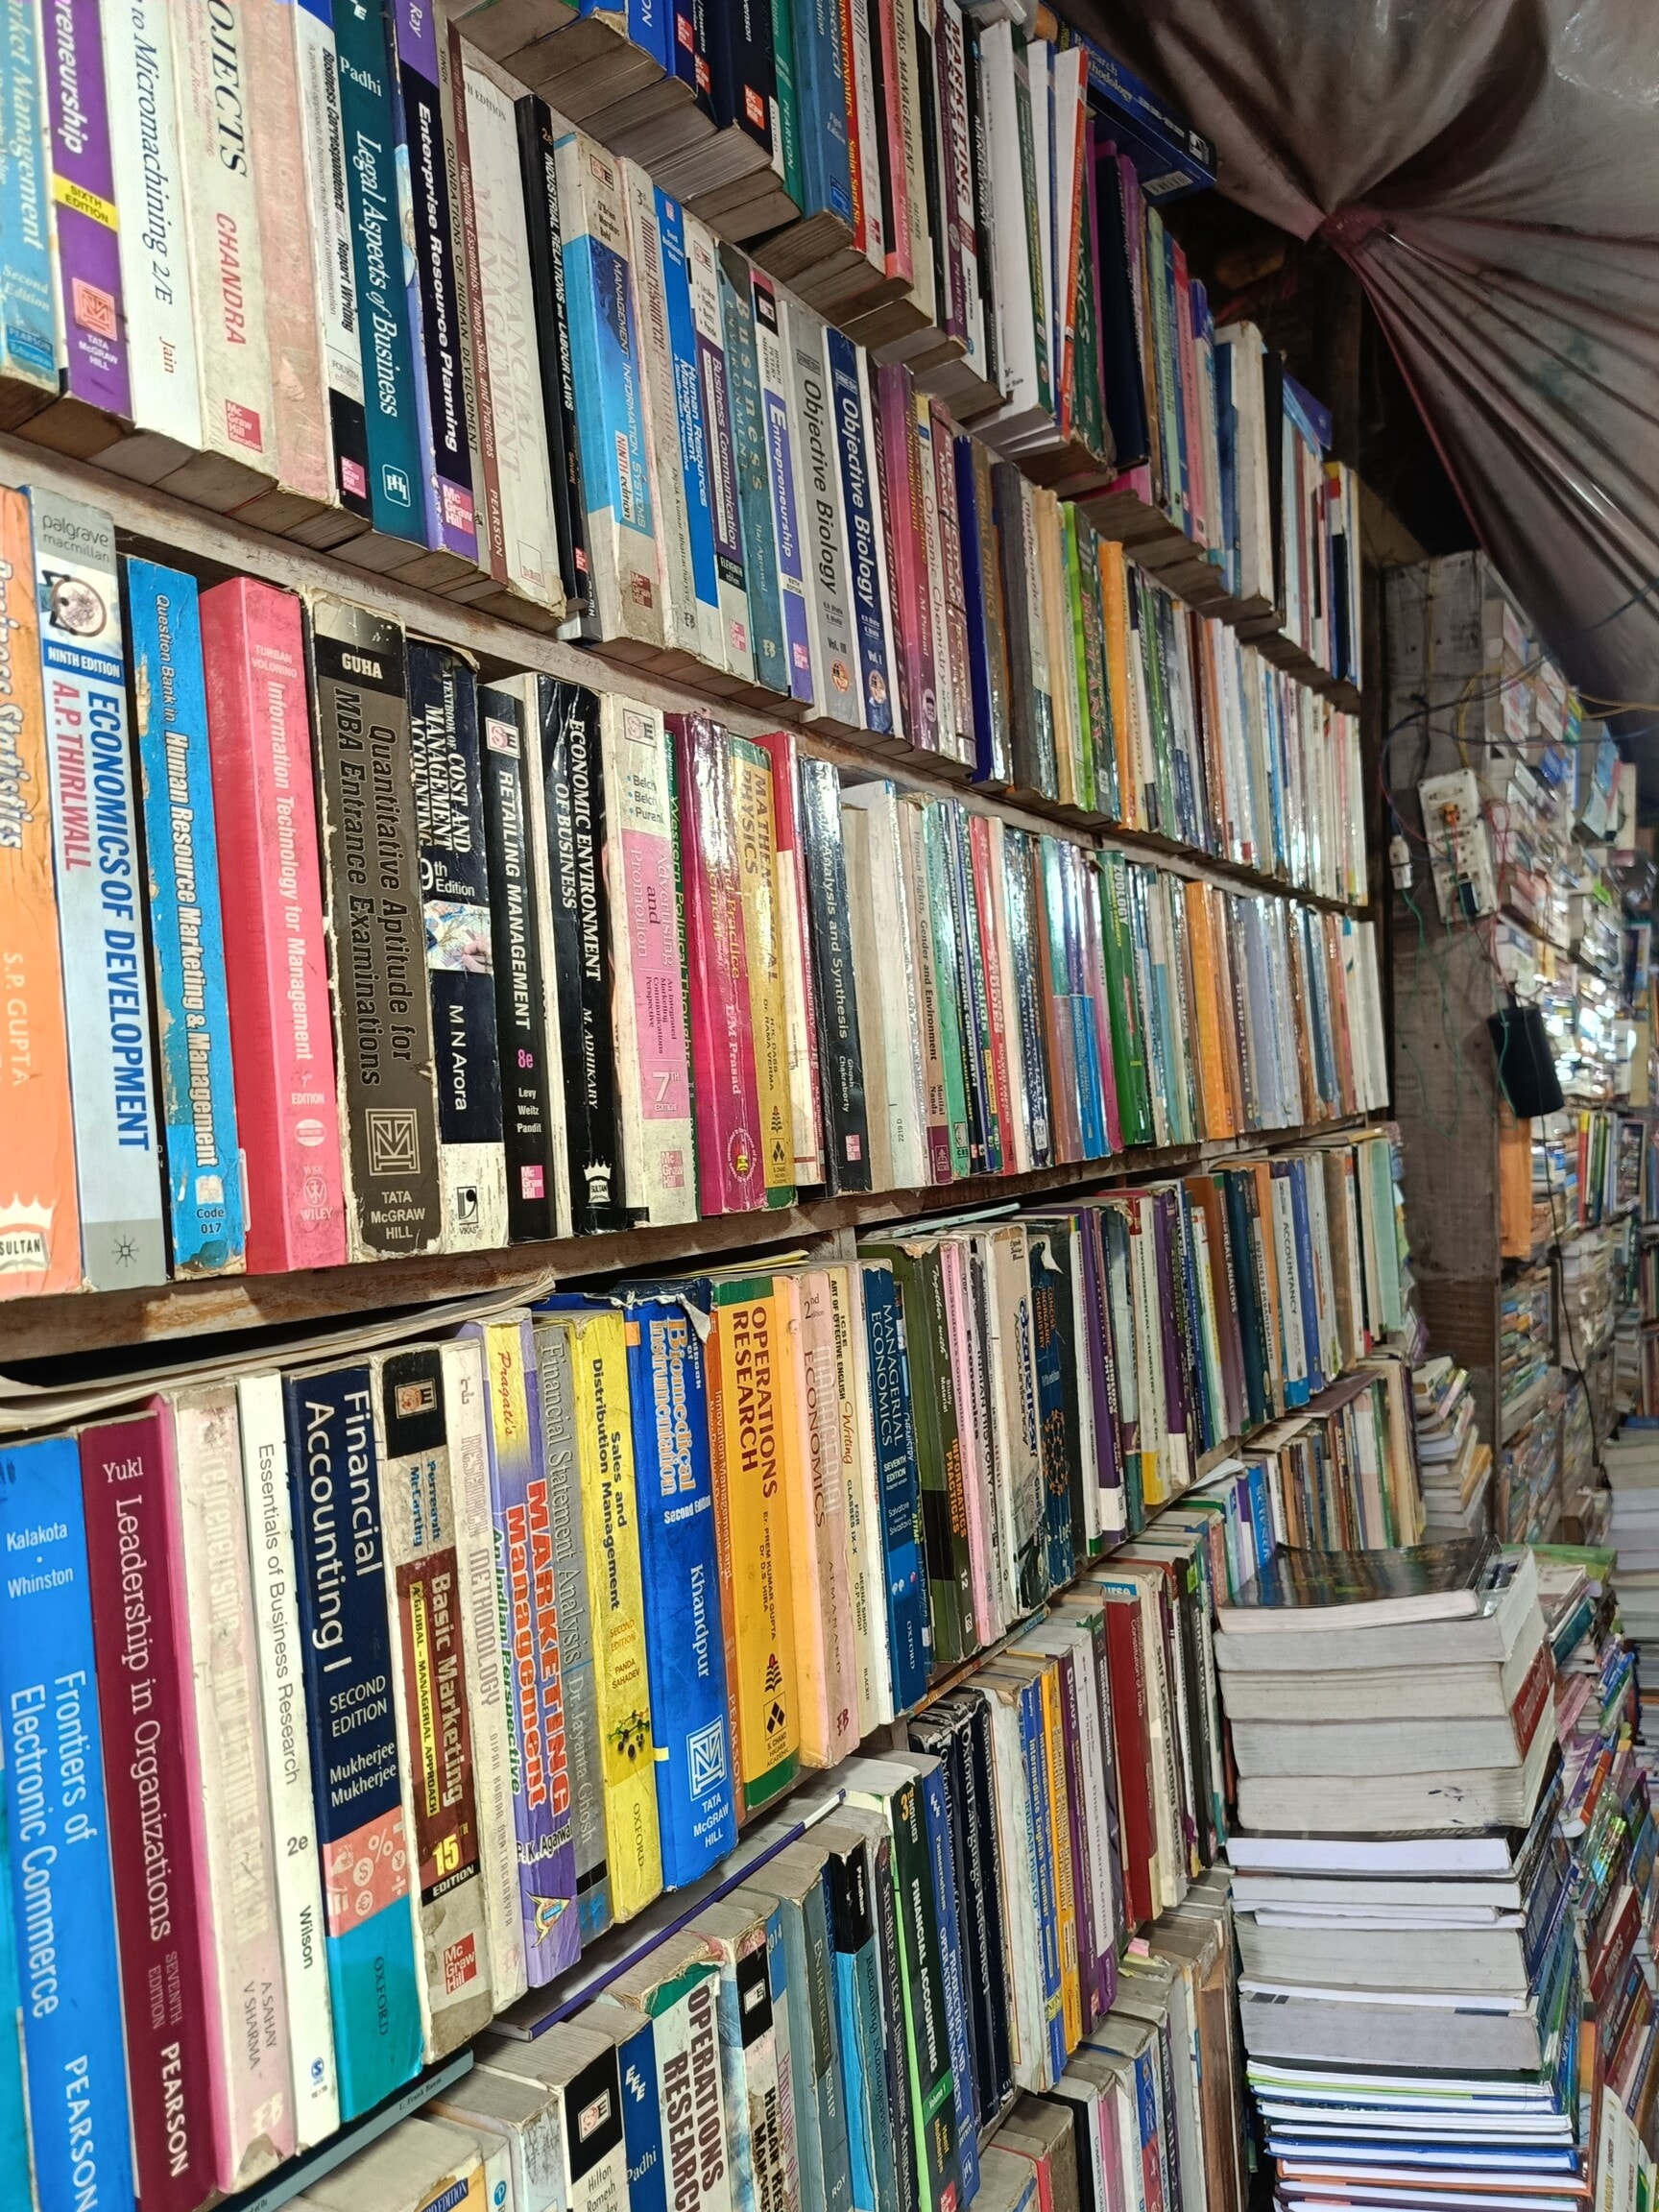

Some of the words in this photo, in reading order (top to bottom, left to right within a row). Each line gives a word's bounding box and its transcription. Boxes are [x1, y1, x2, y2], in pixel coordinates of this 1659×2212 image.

[339, 56, 382, 97] Padhi
[782, 98, 795, 170] PEARSON
[898, 58, 915, 176] MANAGEMENT
[951, 21, 971, 206] MARKETING
[70, 185, 103, 209] SIXTH
[352, 130, 387, 204] Legal
[419, 102, 440, 230] Enterprise
[65, 196, 110, 225] EDITION
[358, 198, 392, 291] Aspects
[216, 212, 247, 345] CHANDRA
[365, 290, 392, 318] of
[428, 234, 450, 348] Resource
[159, 336, 178, 373] Jain
[372, 313, 400, 418] Business
[439, 351, 459, 452] Planning
[770, 403, 793, 558] Entrepreneurship
[803, 379, 828, 492] Objective
[816, 500, 839, 594] Biology
[840, 397, 868, 509] Objective
[41, 513, 109, 547] palgrave
[42, 532, 110, 564] macmillan
[490, 488, 505, 566] PEARSON
[853, 515, 876, 609] Biology
[923, 494, 939, 580] Organic
[932, 586, 948, 691] Chemistry
[156, 593, 177, 662] Question
[48, 646, 83, 670] NINTH
[81, 653, 122, 679] EDITION
[160, 664, 177, 706] Bank
[341, 651, 383, 681] GUHA
[53, 679, 83, 727] A.P.
[164, 707, 177, 725] in
[265, 679, 295, 791] Information
[333, 686, 365, 752] MBA
[87, 689, 132, 880] ECONOMICS
[163, 728, 190, 805] Human
[424, 703, 455, 854] MANAGEMENT
[446, 752, 470, 806] COST
[555, 781, 570, 817] OF
[569, 718, 594, 840] ECONOMIC
[632, 776, 657, 792] Belch
[56, 732, 92, 872] THIRLWALL
[339, 758, 369, 886] Entrance
[367, 723, 406, 890] Quantitative
[450, 808, 474, 854] AND
[498, 768, 522, 878] RETAILING
[169, 805, 198, 904] Resource
[276, 795, 302, 900] Technology
[556, 820, 578, 909] BUSINESS
[100, 879, 134, 922] OF
[284, 905, 304, 932] for
[436, 878, 476, 898] Edition
[578, 841, 602, 982] ENVIRONMENT
[646, 886, 661, 924] and
[3, 950, 26, 989] S.P.
[177, 904, 207, 1013] Marketing
[377, 898, 416, 1015] Aptitude
[505, 883, 532, 1031] MANAGEMENT
[826, 923, 843, 957] and
[920, 920, 931, 961] Gender
[287, 938, 315, 1061] Management
[348, 893, 389, 1087] Examinations
[829, 961, 850, 1039] Synthesis
[923, 964, 933, 985] and
[6, 998, 32, 1088] GUPTA
[104, 928, 150, 1151] DEVELOPMENT
[183, 1012, 206, 1030] &
[386, 1022, 417, 1064] for
[924, 989, 939, 1061] Environment
[517, 1048, 535, 1070] 8e
[837, 1054, 850, 1116] Chakraborty
[846, 1058, 855, 1089] Ghosh
[186, 1029, 221, 1169] Management
[517, 1120, 542, 1135] Pandit
[518, 1087, 538, 1100] Levy
[518, 1104, 540, 1117] Weitz
[930, 1086, 939, 1115] Nanda
[196, 1206, 225, 1219] Code
[200, 1221, 223, 1236] 017
[300, 1207, 334, 1222] WILEY
[370, 1207, 426, 1225] McGRAW
[382, 1190, 413, 1205] TATA
[0, 1238, 41, 1256] SULTAN
[385, 1225, 414, 1240] HILL
[1226, 1262, 1238, 1313] ANALYSIS
[1282, 1221, 1298, 1315] ACCOUNTANCY
[1035, 1290, 1046, 1350] CHEMISTRY
[1039, 1287, 1051, 1347] INORGANIC
[496, 1350, 515, 1437] Pragati's
[541, 1344, 574, 1450] Financial
[649, 1319, 679, 1497] Instrumentation
[667, 1315, 697, 1494] Biomedical
[732, 1309, 760, 1474] RESEARCH
[751, 1305, 780, 1500] OPERATIONS
[837, 1361, 847, 1401] ENGLISH
[871, 1311, 894, 1447] ECONOMICS
[882, 1305, 904, 1447] MANAGERIAL
[592, 1358, 615, 1475] Distribution
[805, 1351, 828, 1527] ECONOMICS
[841, 1401, 856, 1465] Writing
[103, 1456, 144, 1484] Yukl
[343, 1389, 385, 1577] Financial
[611, 1430, 624, 1484] Sales
[883, 1455, 908, 1473] SEVENTH
[886, 1467, 907, 1484] EDITION
[950, 1438, 969, 1539] INFORMATICS
[258, 1443, 282, 1551] Essentials
[304, 1400, 347, 1650] Accounting
[548, 1449, 576, 1564] Statement
[615, 1489, 629, 1528] and
[945, 1451, 961, 1544] PRACTICES
[7, 1522, 68, 1551] Kalakota
[267, 1555, 287, 1576] of
[601, 1481, 621, 1613] Management
[8, 1567, 74, 1599] Whinston
[116, 1494, 154, 1672] Leadership
[429, 1572, 457, 1652] Basic
[766, 1561, 775, 1606] KUMAR
[959, 1569, 970, 1591] 12
[270, 1581, 292, 1680] Business
[526, 1478, 574, 1817] MARKETING
[558, 1569, 585, 1667] Analysis
[609, 1618, 637, 1638] SECOND
[610, 1633, 637, 1652] EDITION
[690, 1563, 710, 1679] Khandpur
[904, 1620, 917, 1671] OXFORD
[323, 1656, 353, 1673] I
[505, 1502, 549, 1812] Management
[611, 1668, 641, 1691] SAHADEV
[131, 1678, 156, 1716] in
[328, 1675, 387, 1715] SECOND
[331, 1698, 389, 1738] EDITION
[11, 1683, 58, 1842] Electronic
[54, 1670, 91, 1808] Frontiers
[277, 1683, 301, 1785] Research
[328, 1741, 397, 1785] Mukherjee
[437, 1653, 467, 1809] Marketing
[330, 1764, 397, 1808] Mukherjee
[692, 1801, 730, 1838] McGRAW
[701, 1791, 723, 1815] TATA
[63, 1813, 99, 1844] of
[131, 1719, 173, 1942] Organizations
[287, 1835, 309, 1857] 2e
[633, 1801, 646, 1868] OXFORD
[704, 1829, 724, 1849] HILL
[431, 1863, 476, 1898] EDITION
[22, 1844, 60, 2020] Commerce
[299, 1905, 315, 1969] Wilson
[445, 1950, 477, 1981] Graw
[149, 1964, 165, 2031] EDITION
[165, 1951, 183, 2026] SEVENTH
[373, 1955, 391, 2036] OXFORD
[446, 1970, 467, 1995] Hill
[911, 1877, 927, 1965] FINANCIAL
[920, 1966, 939, 2074] ACCOUNTING
[949, 1949, 963, 2041] PRODUCTION
[244, 1998, 262, 2072] SHARMA
[159, 2041, 190, 2178] PEARSON
[686, 1984, 725, 2193] OPERATIONS
[64, 2055, 100, 2212] PEARSON
[763, 2084, 782, 2167] HUMAN
[587, 2163, 613, 2195] Hilton
[626, 2145, 659, 2186] Padhi
[830, 2173, 847, 2199] ROY
